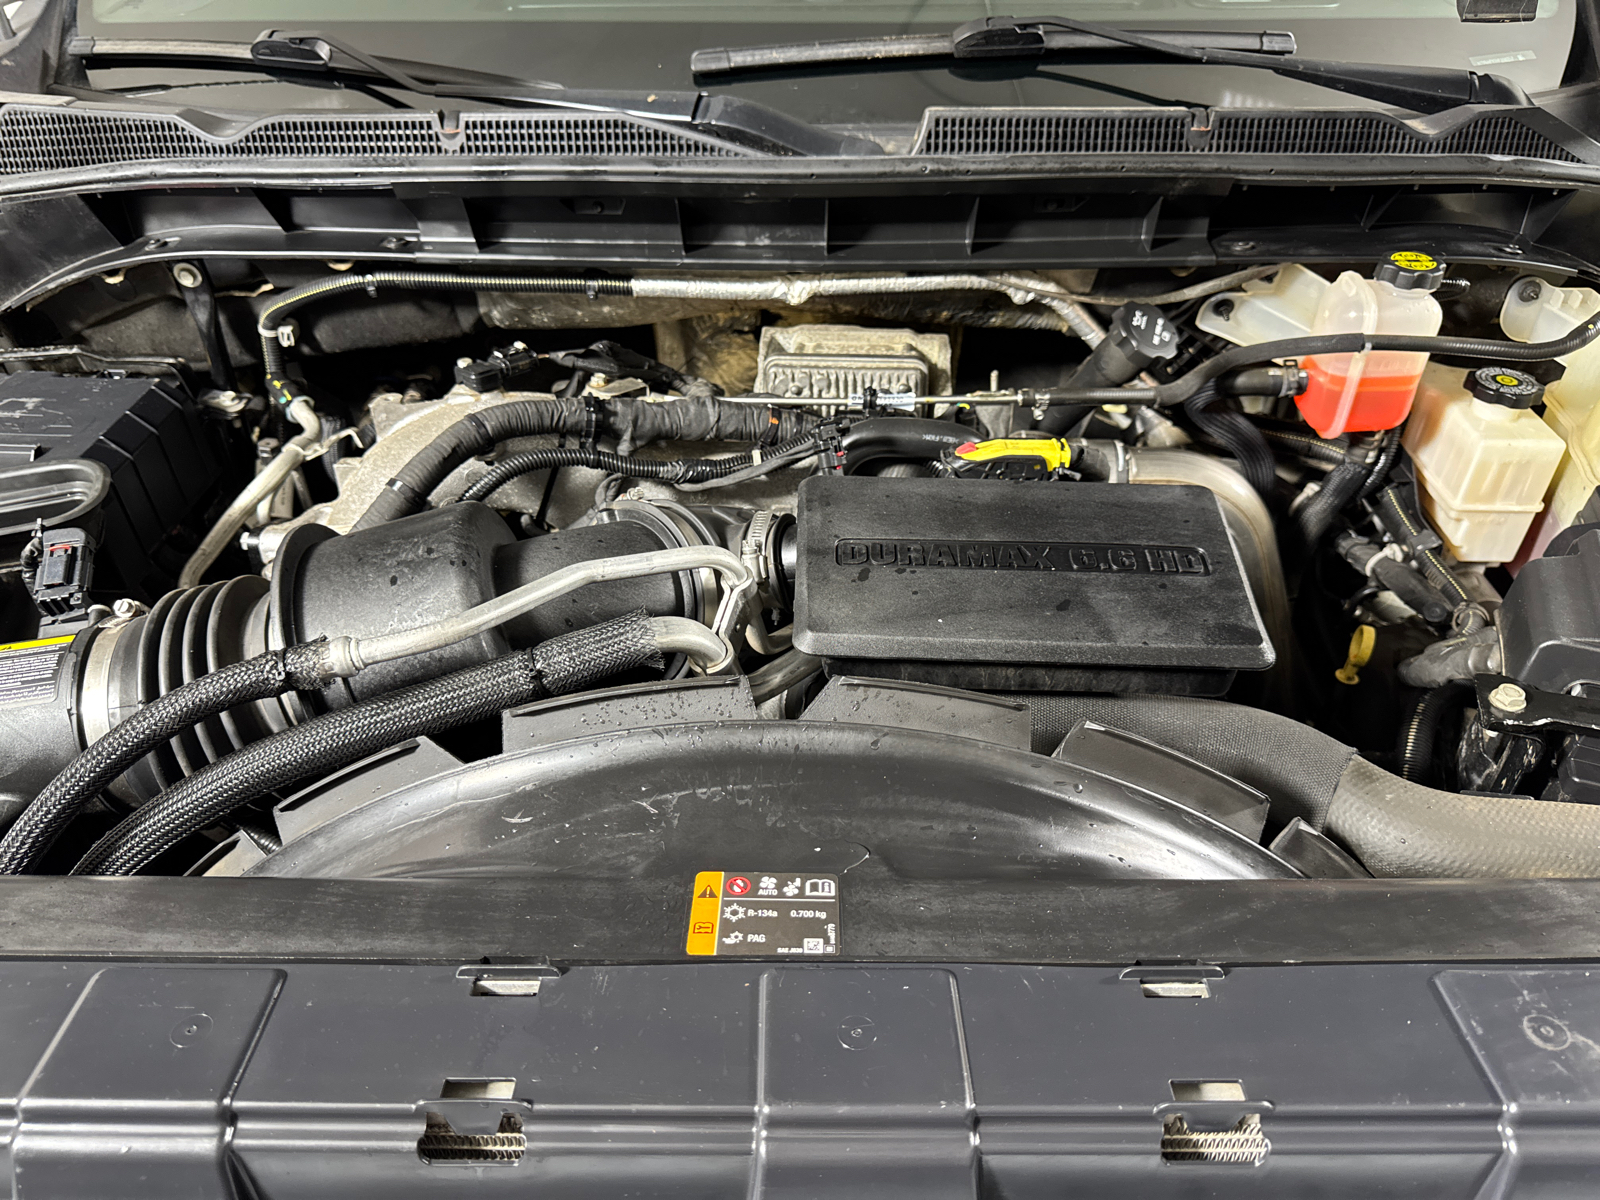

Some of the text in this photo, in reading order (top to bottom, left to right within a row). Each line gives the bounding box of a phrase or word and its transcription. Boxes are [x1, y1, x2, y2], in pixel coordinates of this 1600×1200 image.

[841, 541, 1055, 569] DURAMAX
[1144, 549, 1206, 574] HD
[747, 909, 827, 920] R-134a 0.700 kg
[747, 934, 766, 943] PAG
